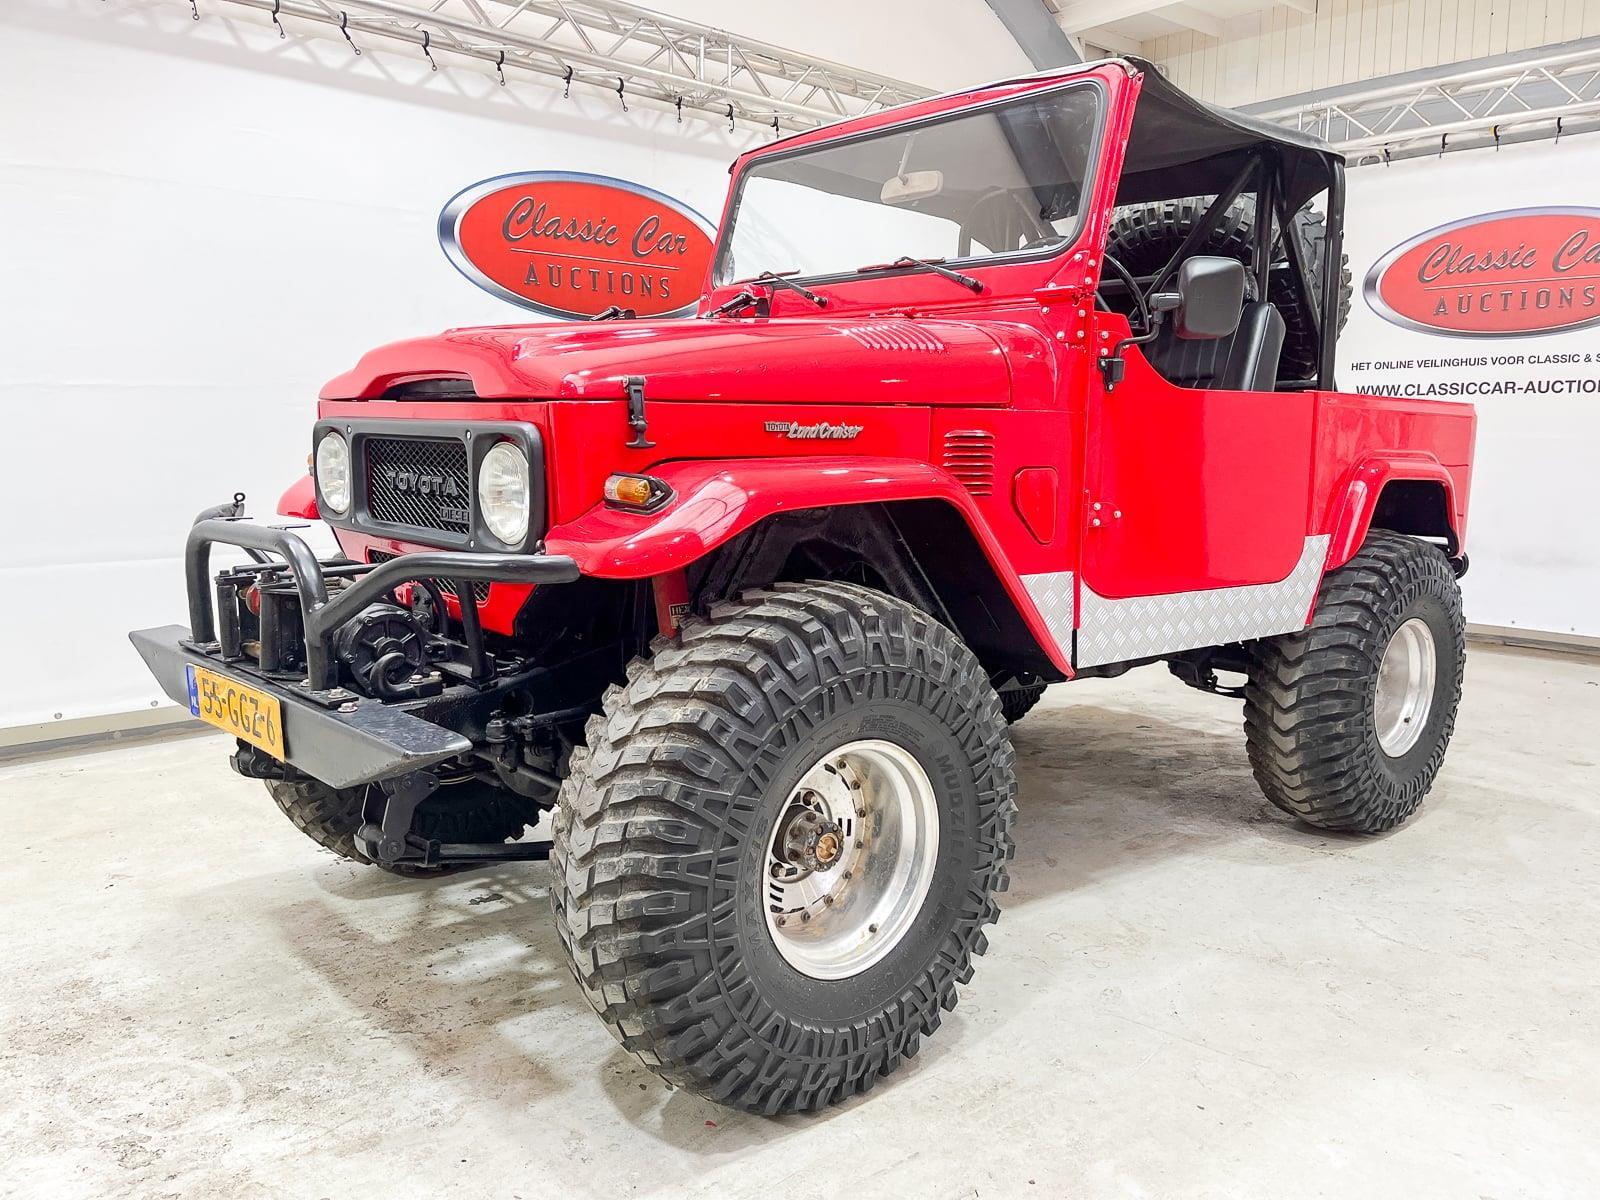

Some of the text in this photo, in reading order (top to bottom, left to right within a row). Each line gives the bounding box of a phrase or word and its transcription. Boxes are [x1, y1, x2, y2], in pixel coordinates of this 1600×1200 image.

[502, 196, 688, 257] Classic Car
[1418, 242, 1537, 283] Classic
[524, 262, 670, 298] AUCTIONS
[1433, 285, 1595, 316] AUCTIONS
[1351, 362, 1371, 371] HET
[1374, 360, 1414, 370] ONLINE
[1417, 357, 1487, 368] VEILINGHUIS
[1491, 355, 1524, 365] VOOR
[1528, 353, 1580, 364] CLASSIC
[1583, 353, 1592, 363] &
[1356, 379, 1600, 396] WWW.CLASSICCAR-AUCTIO
[386, 470, 459, 497] TOYOTA
